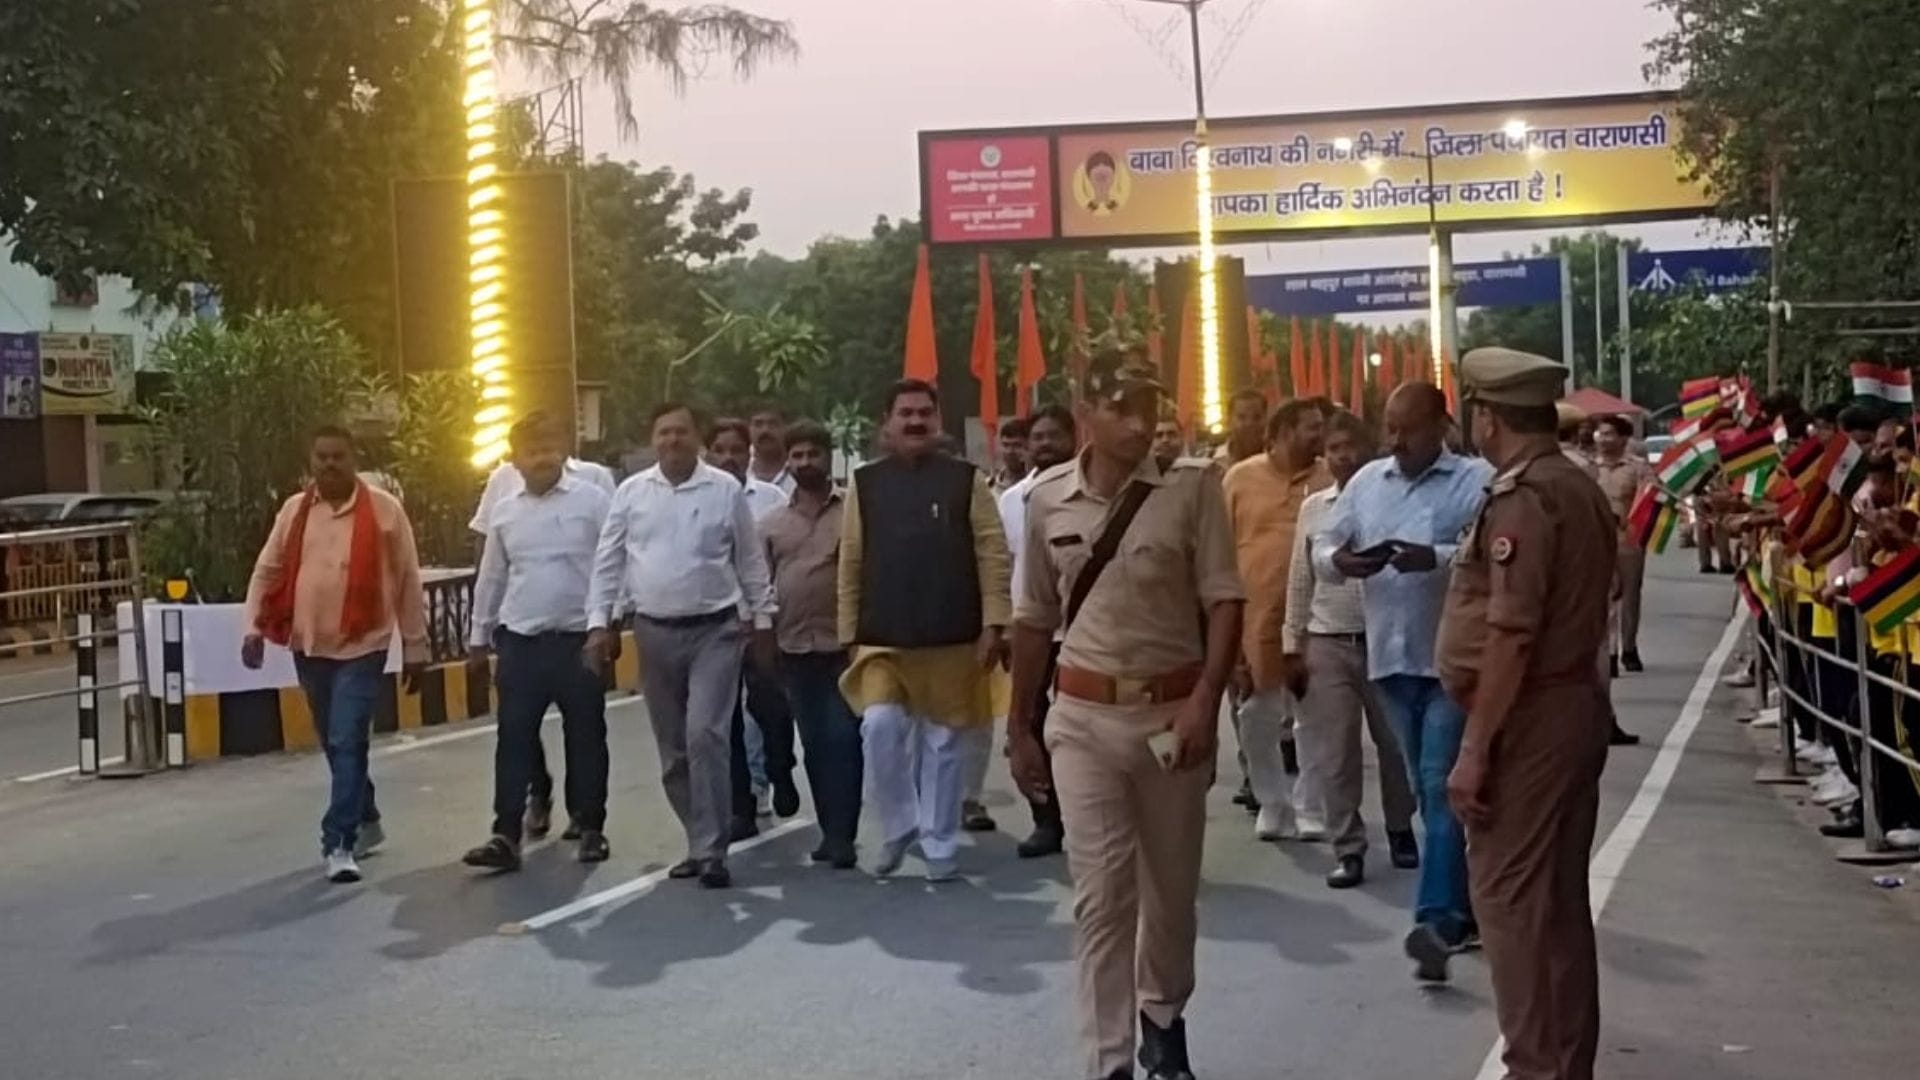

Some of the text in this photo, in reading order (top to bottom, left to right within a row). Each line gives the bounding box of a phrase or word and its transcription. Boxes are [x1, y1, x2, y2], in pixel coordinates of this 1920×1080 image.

[1280, 135, 1309, 164] की
[1574, 114, 1666, 148] वाराणसी
[1276, 182, 1344, 215] हार्दिक
[1352, 177, 1451, 209] अभिनंदन
[1459, 180, 1520, 202] करता
[1527, 170, 1545, 202] है
